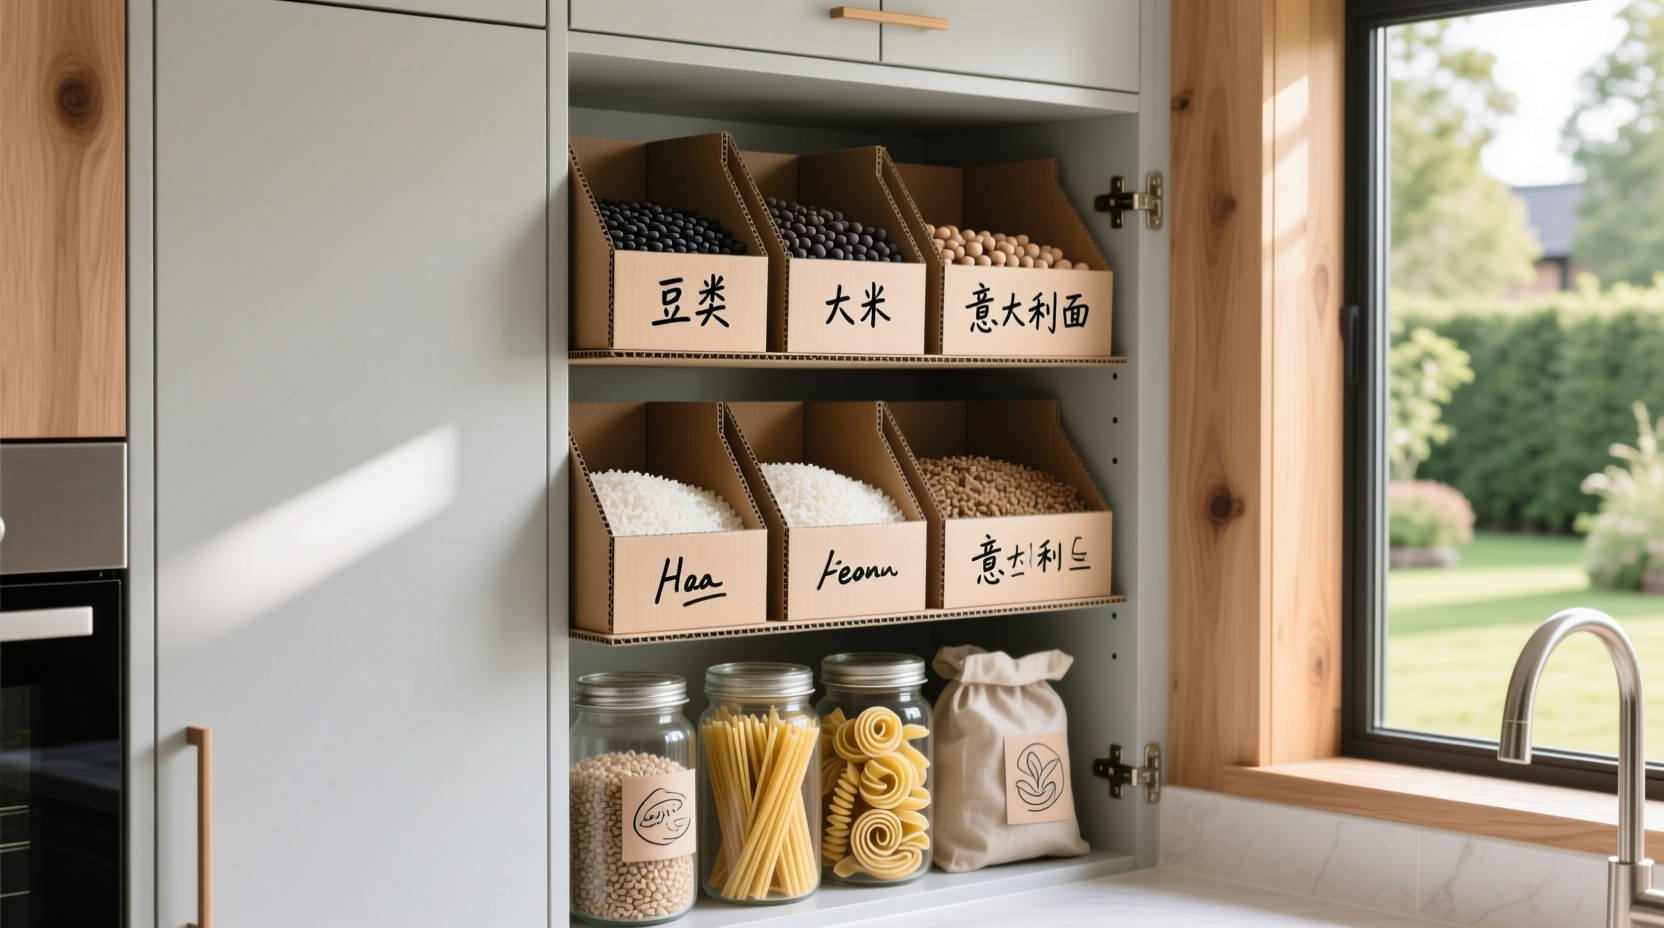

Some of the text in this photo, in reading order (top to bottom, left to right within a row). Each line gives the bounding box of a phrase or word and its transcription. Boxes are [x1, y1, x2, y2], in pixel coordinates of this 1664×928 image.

[651, 273, 730, 328] 豆类
[825, 281, 891, 329] 大米
[964, 282, 1090, 335] 意大利面
